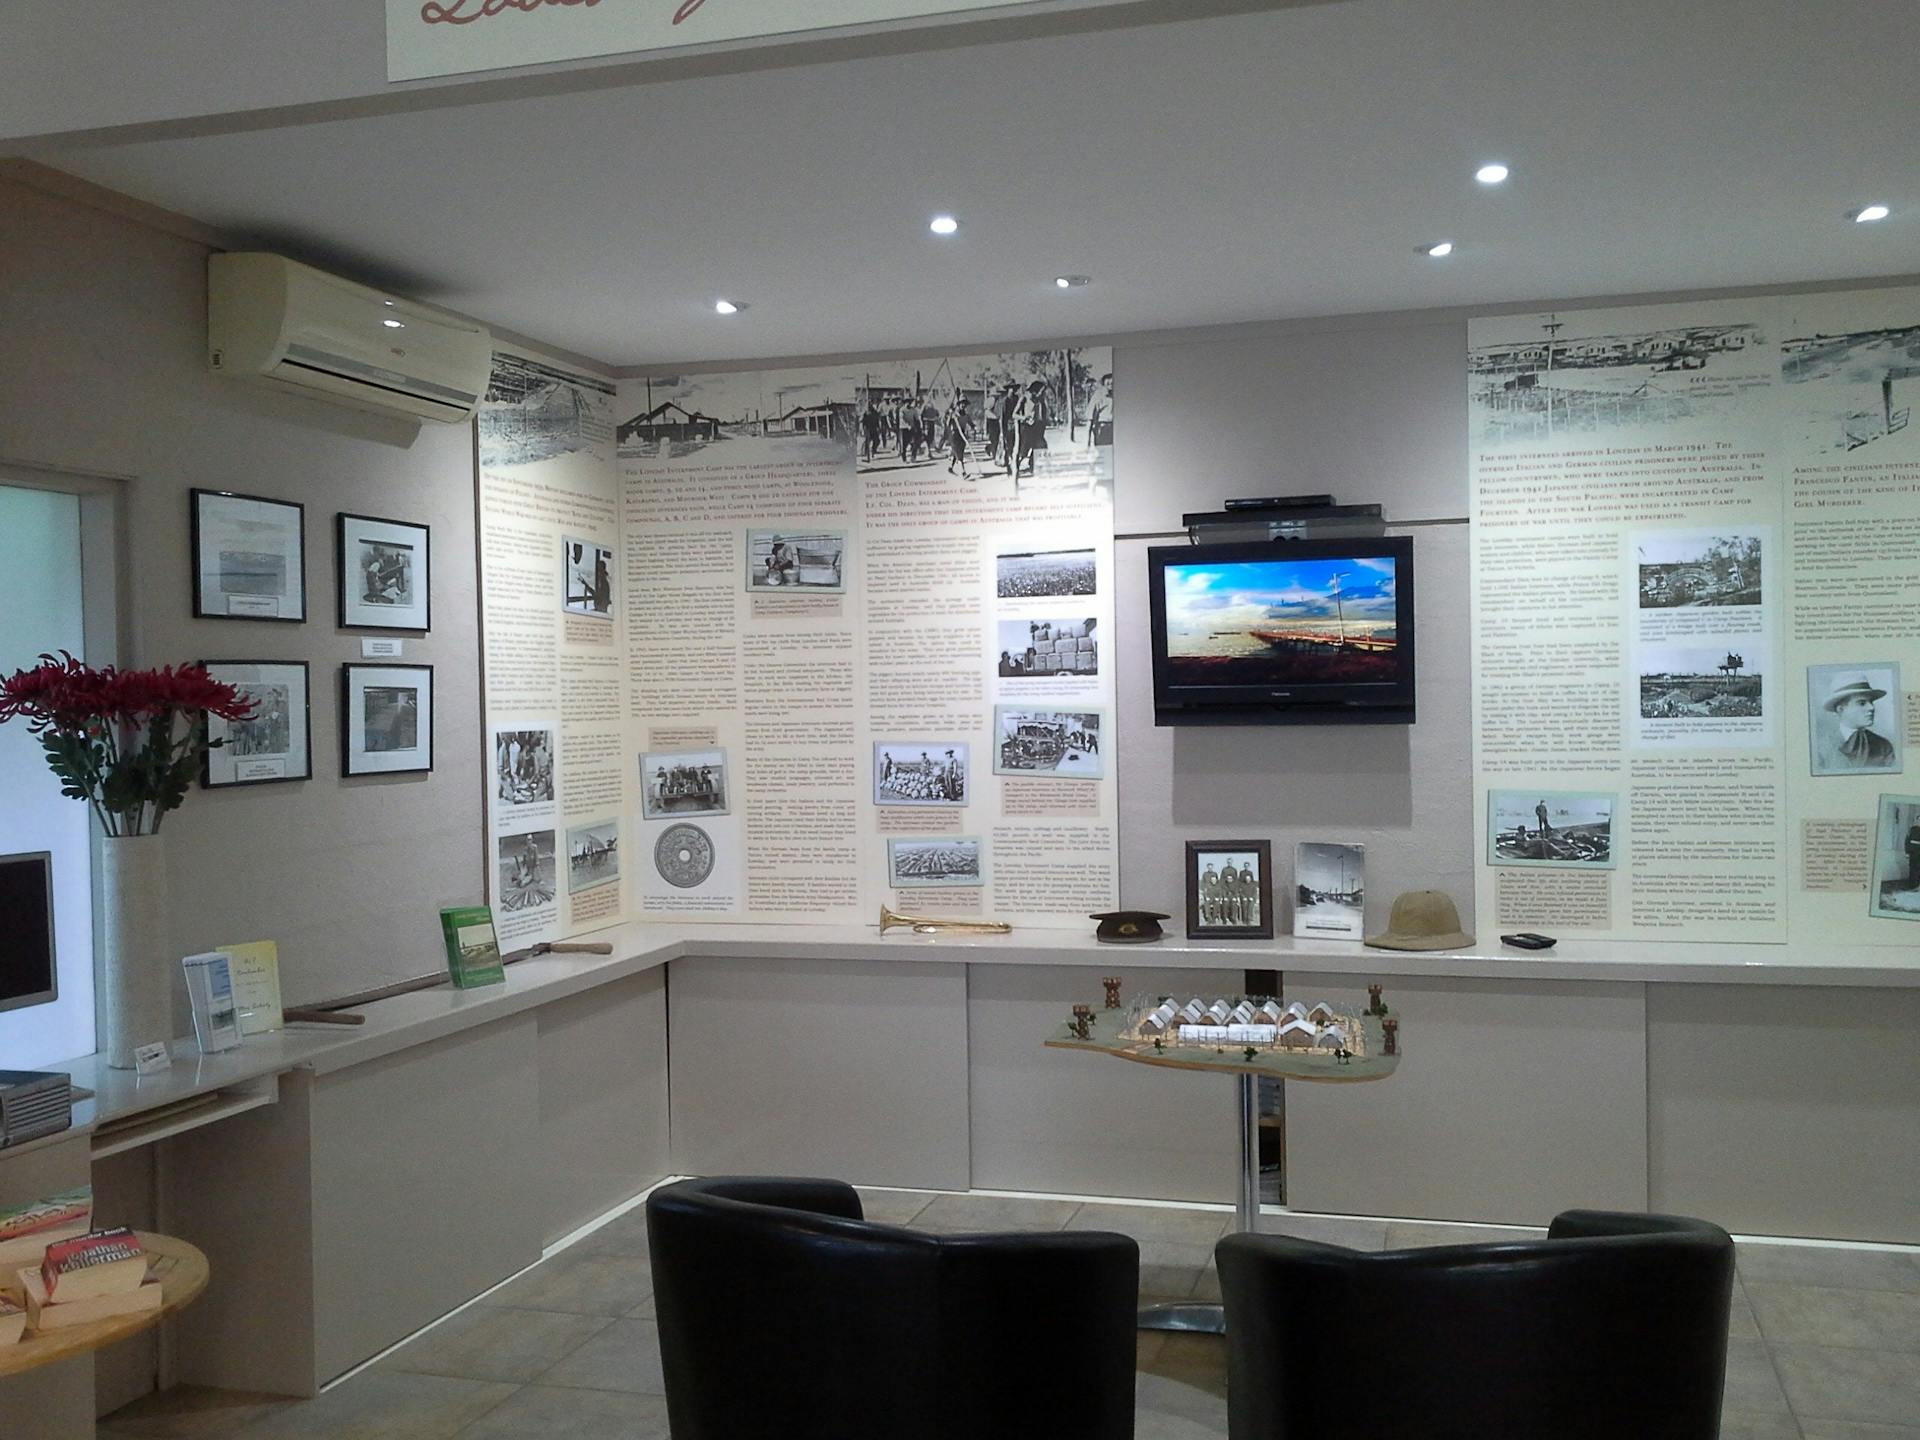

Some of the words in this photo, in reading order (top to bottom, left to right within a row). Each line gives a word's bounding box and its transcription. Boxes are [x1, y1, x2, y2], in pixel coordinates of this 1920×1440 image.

[104, 1226, 127, 1236] book
[59, 1247, 142, 1272] kellerman
[66, 1242, 128, 1262] jonathan
